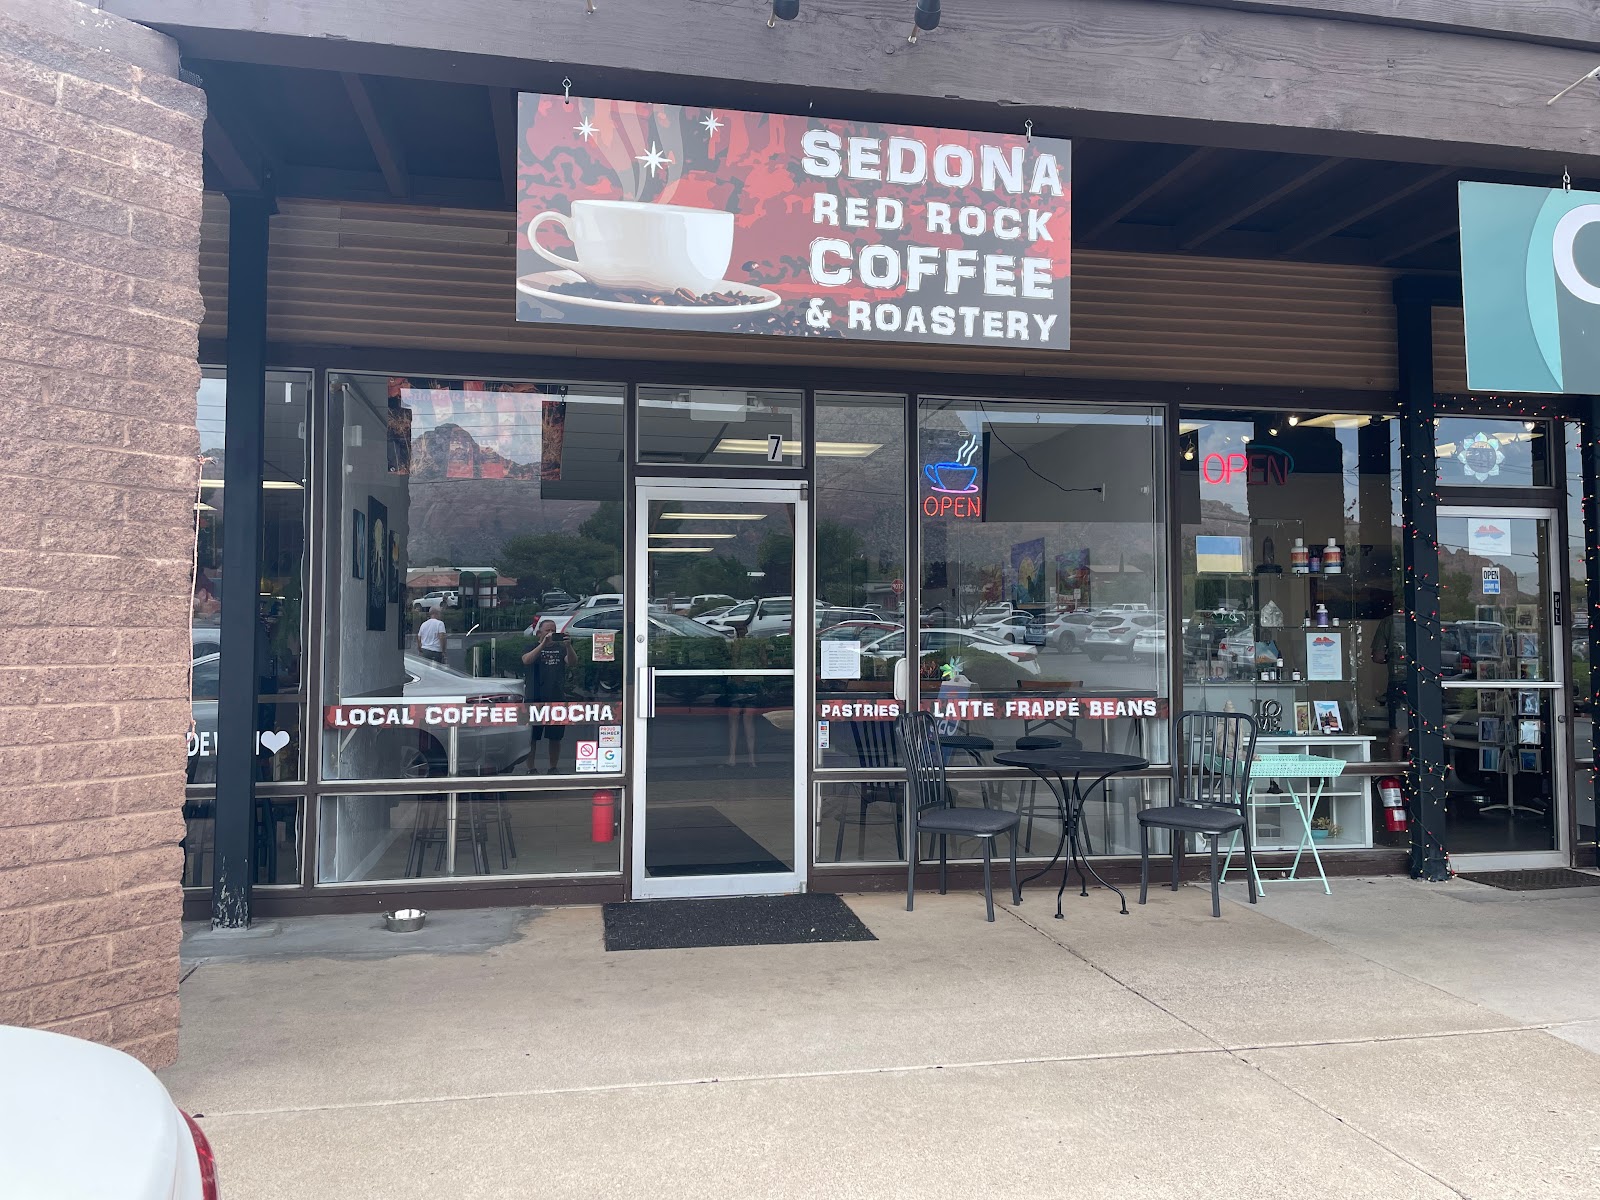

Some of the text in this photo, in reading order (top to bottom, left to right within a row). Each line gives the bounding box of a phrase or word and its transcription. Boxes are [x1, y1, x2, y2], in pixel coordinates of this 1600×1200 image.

[801, 129, 1065, 197] SEDONA
[813, 192, 1055, 243] RED ROCK
[809, 236, 1054, 300] COFFEE
[806, 297, 1058, 342] & ROASTERY
[770, 435, 781, 460] 7
[1203, 453, 1289, 486] OPEN
[923, 495, 981, 518] OPEN
[1483, 570, 1499, 580] OPEN
[335, 704, 614, 726] LOCAL COFFEE MOCHA
[822, 703, 900, 718] PASTRIES
[933, 698, 1157, 718] LATTE FRAPPÉ BEANS
